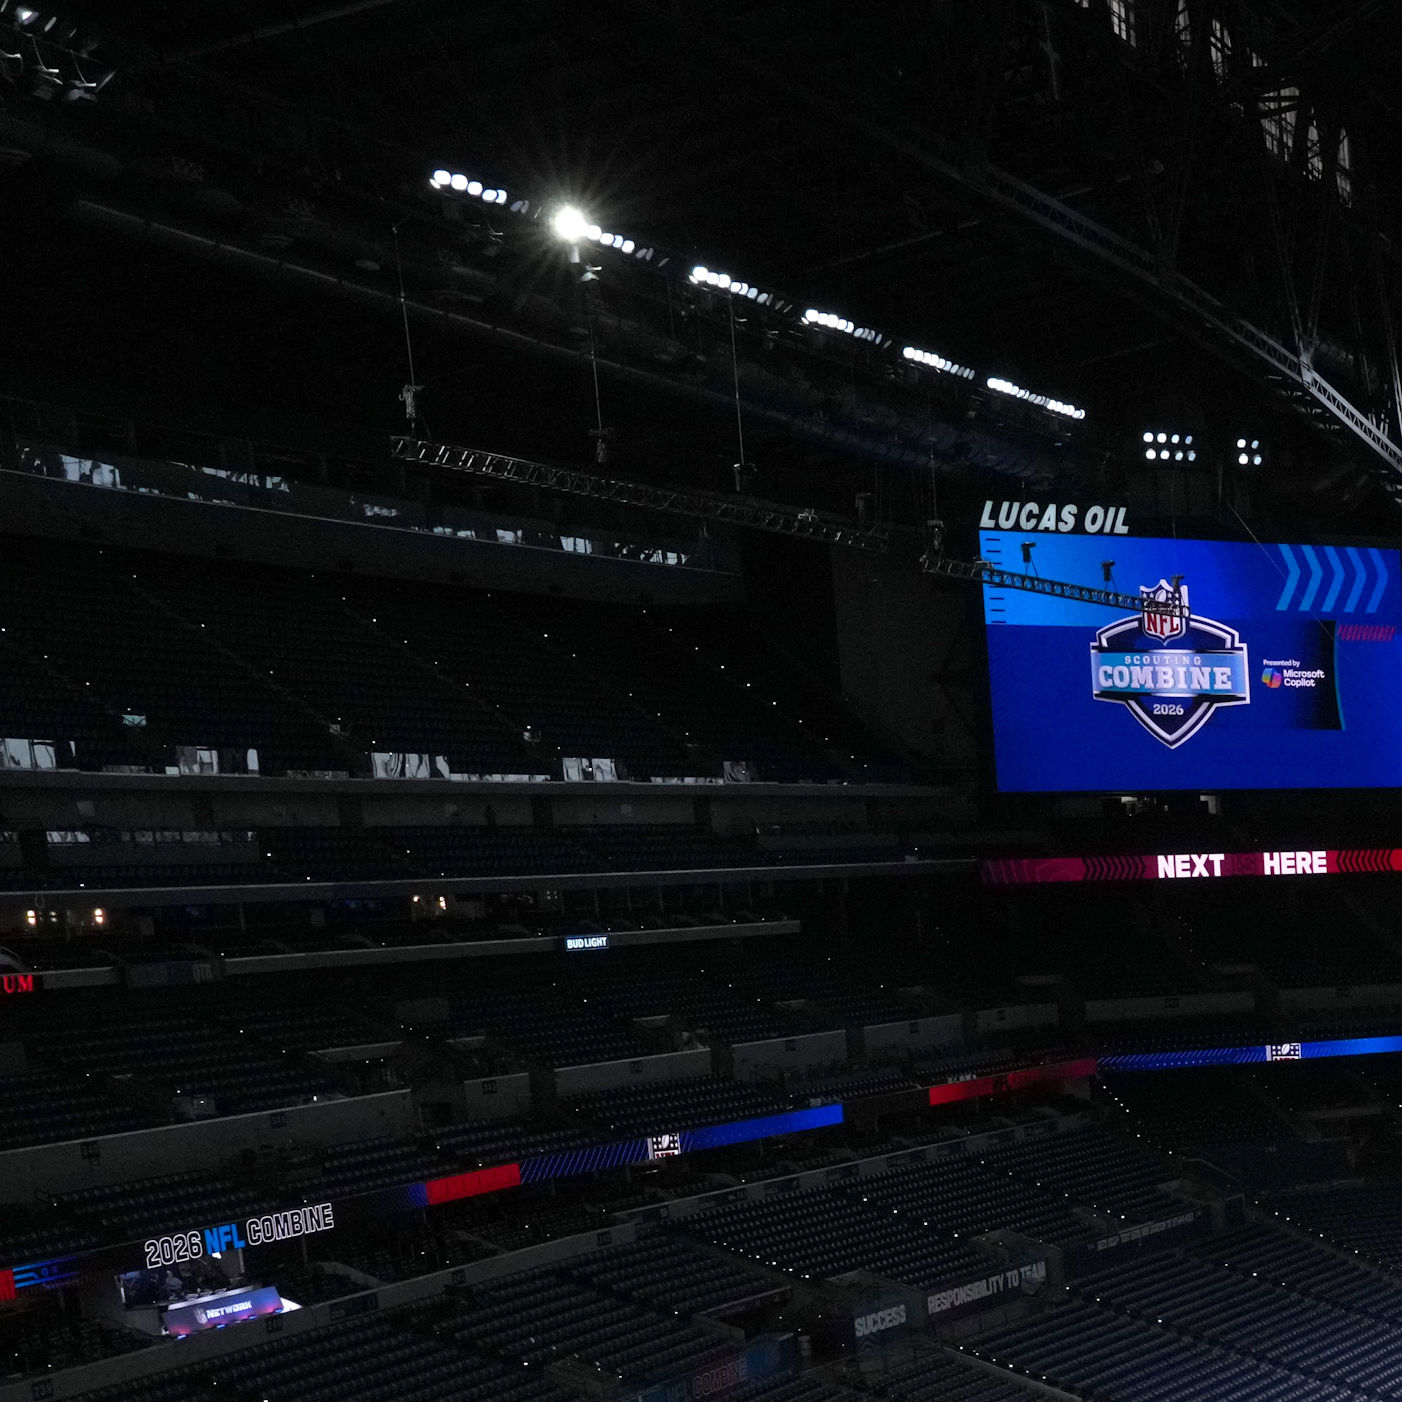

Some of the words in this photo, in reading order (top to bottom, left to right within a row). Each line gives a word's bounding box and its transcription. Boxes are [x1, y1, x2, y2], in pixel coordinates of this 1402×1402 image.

[980, 500, 1077, 531] LUCAS
[1084, 505, 1130, 534] OIL
[1124, 655, 1201, 666] SCOUTING
[1098, 666, 1232, 690] COMBINE
[1282, 668, 1325, 679] Microsoft
[1283, 677, 1315, 688] Copilot
[1152, 703, 1184, 716] 2026
[1157, 853, 1226, 879] NEXT
[1263, 851, 1328, 875] HERE
[567, 938, 583, 950] BUD
[584, 936, 608, 949] LIGHT
[145, 1231, 203, 1269] 2026
[203, 1223, 246, 1256] NFL
[246, 1202, 336, 1246] COMBINE
[928, 1273, 1004, 1315] RESPONSIBILITY
[206, 1299, 253, 1320] NETWORK
[854, 1304, 907, 1338] SUCCESS
